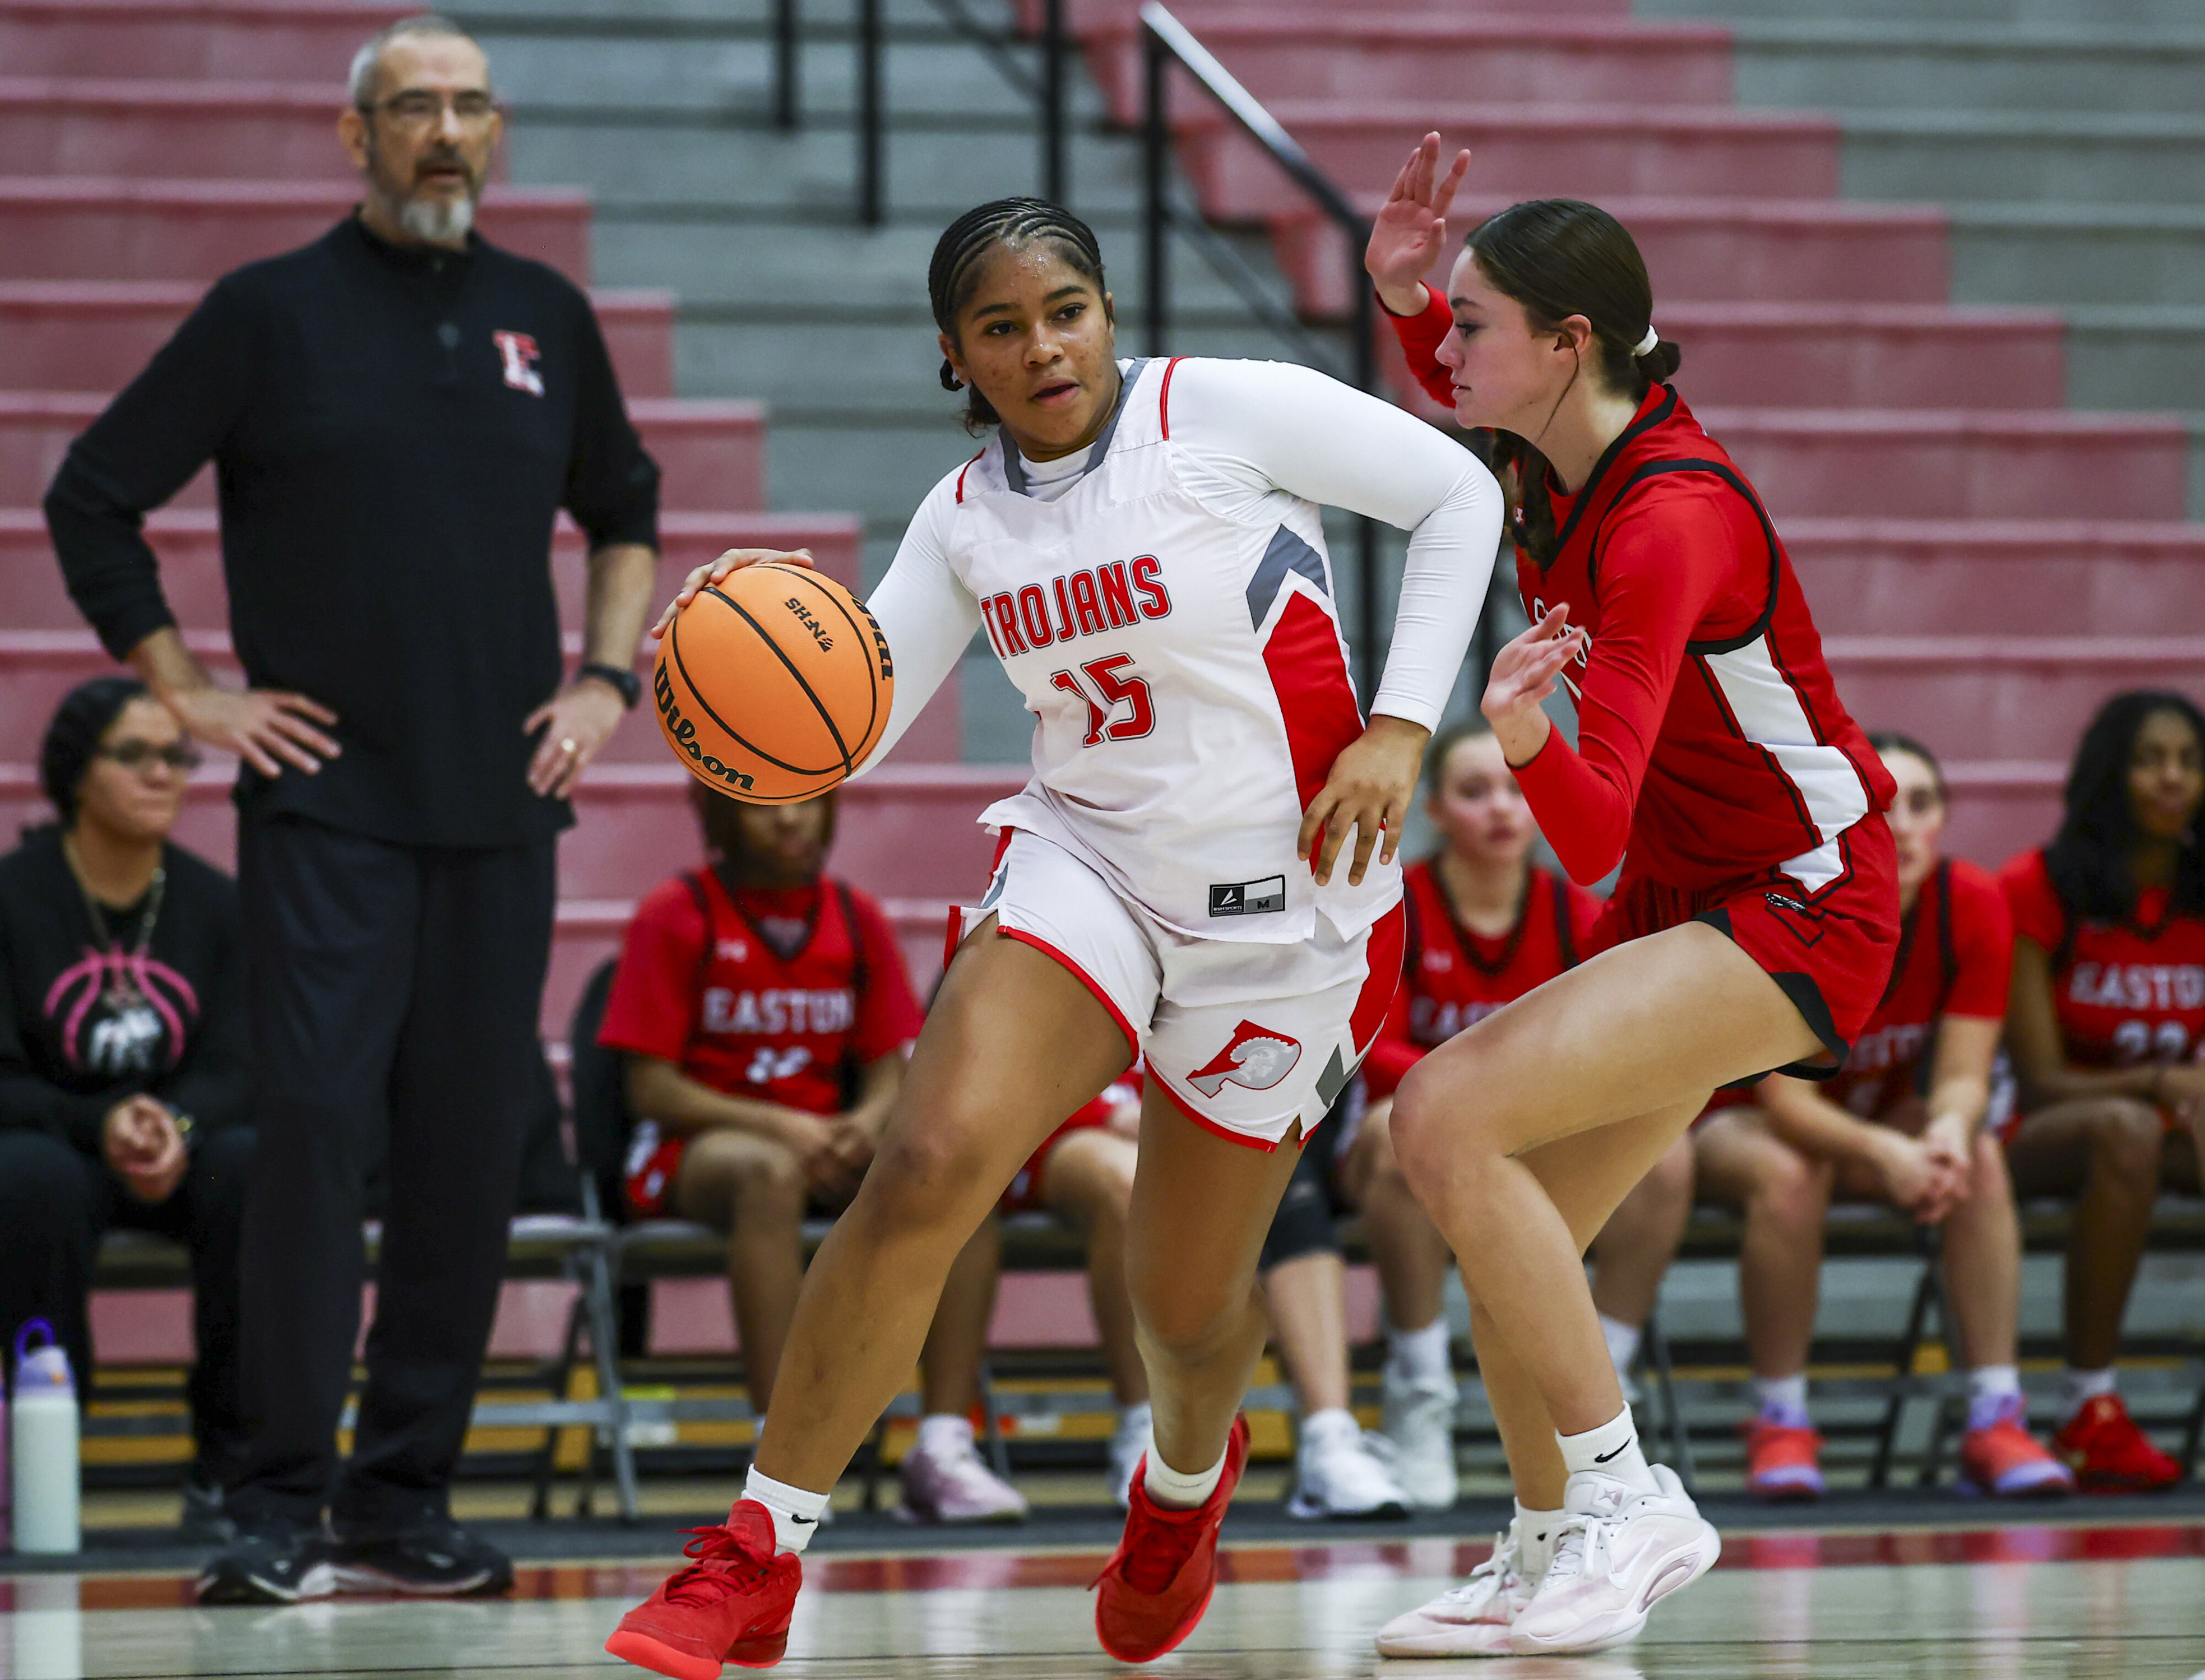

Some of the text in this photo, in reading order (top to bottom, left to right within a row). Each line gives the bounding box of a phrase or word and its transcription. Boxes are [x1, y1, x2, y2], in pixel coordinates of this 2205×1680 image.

[785, 597, 827, 639] NFHS
[981, 554, 1172, 660] TROJANS
[655, 657, 754, 791] Wilson
[1050, 652, 1156, 748] 15
[1257, 899, 1270, 909] M
